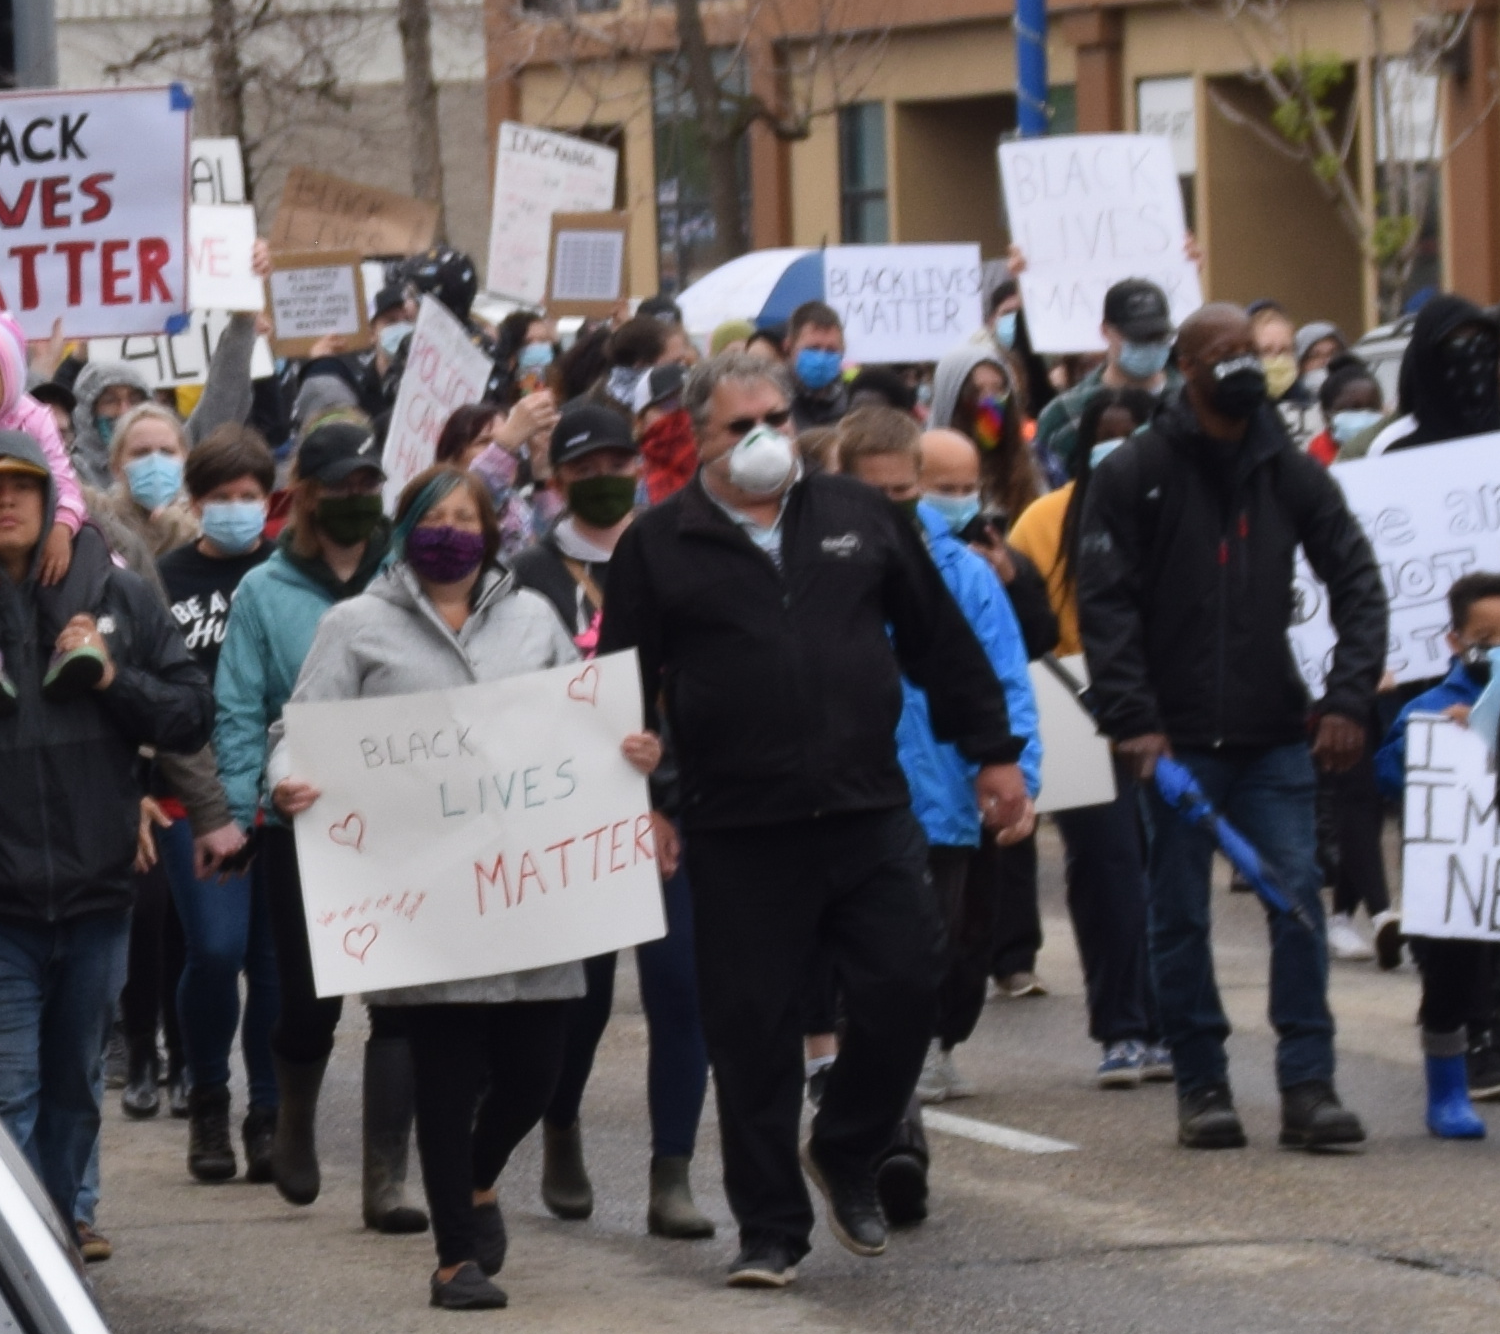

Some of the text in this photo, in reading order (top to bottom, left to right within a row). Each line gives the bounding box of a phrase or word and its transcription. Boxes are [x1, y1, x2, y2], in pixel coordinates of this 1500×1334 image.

[1013, 146, 1157, 205] BLACK
[1022, 203, 1170, 262] LIVES
[830, 267, 982, 297] BLACK LIVES
[844, 297, 962, 334] MATTER
[170, 594, 206, 625] BE
[361, 725, 478, 769] BLACK
[439, 759, 577, 818] LIVES
[473, 812, 658, 915] MATTER
